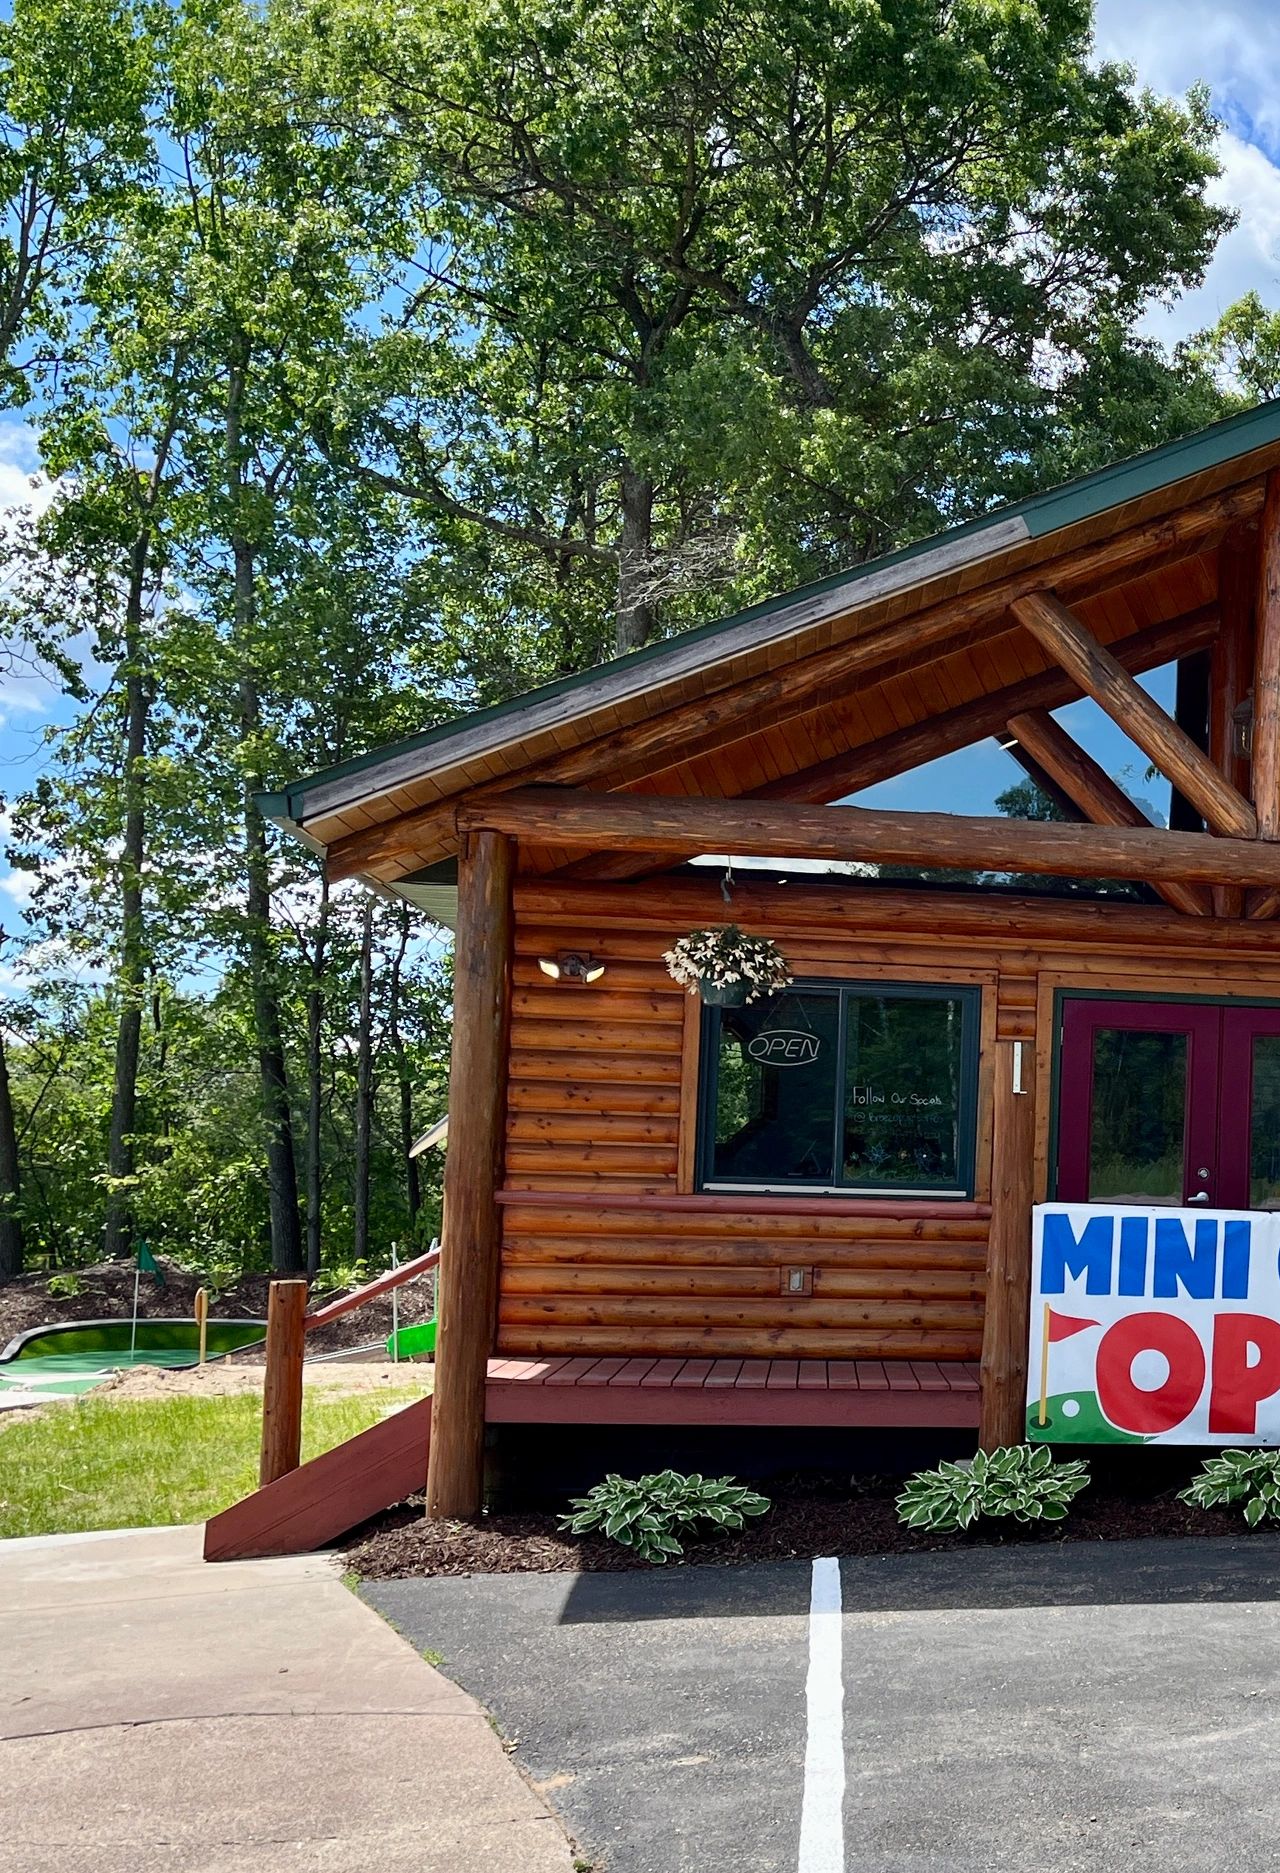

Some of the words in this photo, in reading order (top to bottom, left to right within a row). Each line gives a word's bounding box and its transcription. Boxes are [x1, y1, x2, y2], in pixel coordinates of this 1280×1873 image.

[748, 1037, 820, 1058] OPEN
[852, 1085, 885, 1105] Follow
[890, 1092, 908, 1104] Our
[1040, 1213, 1251, 1300] MINI
